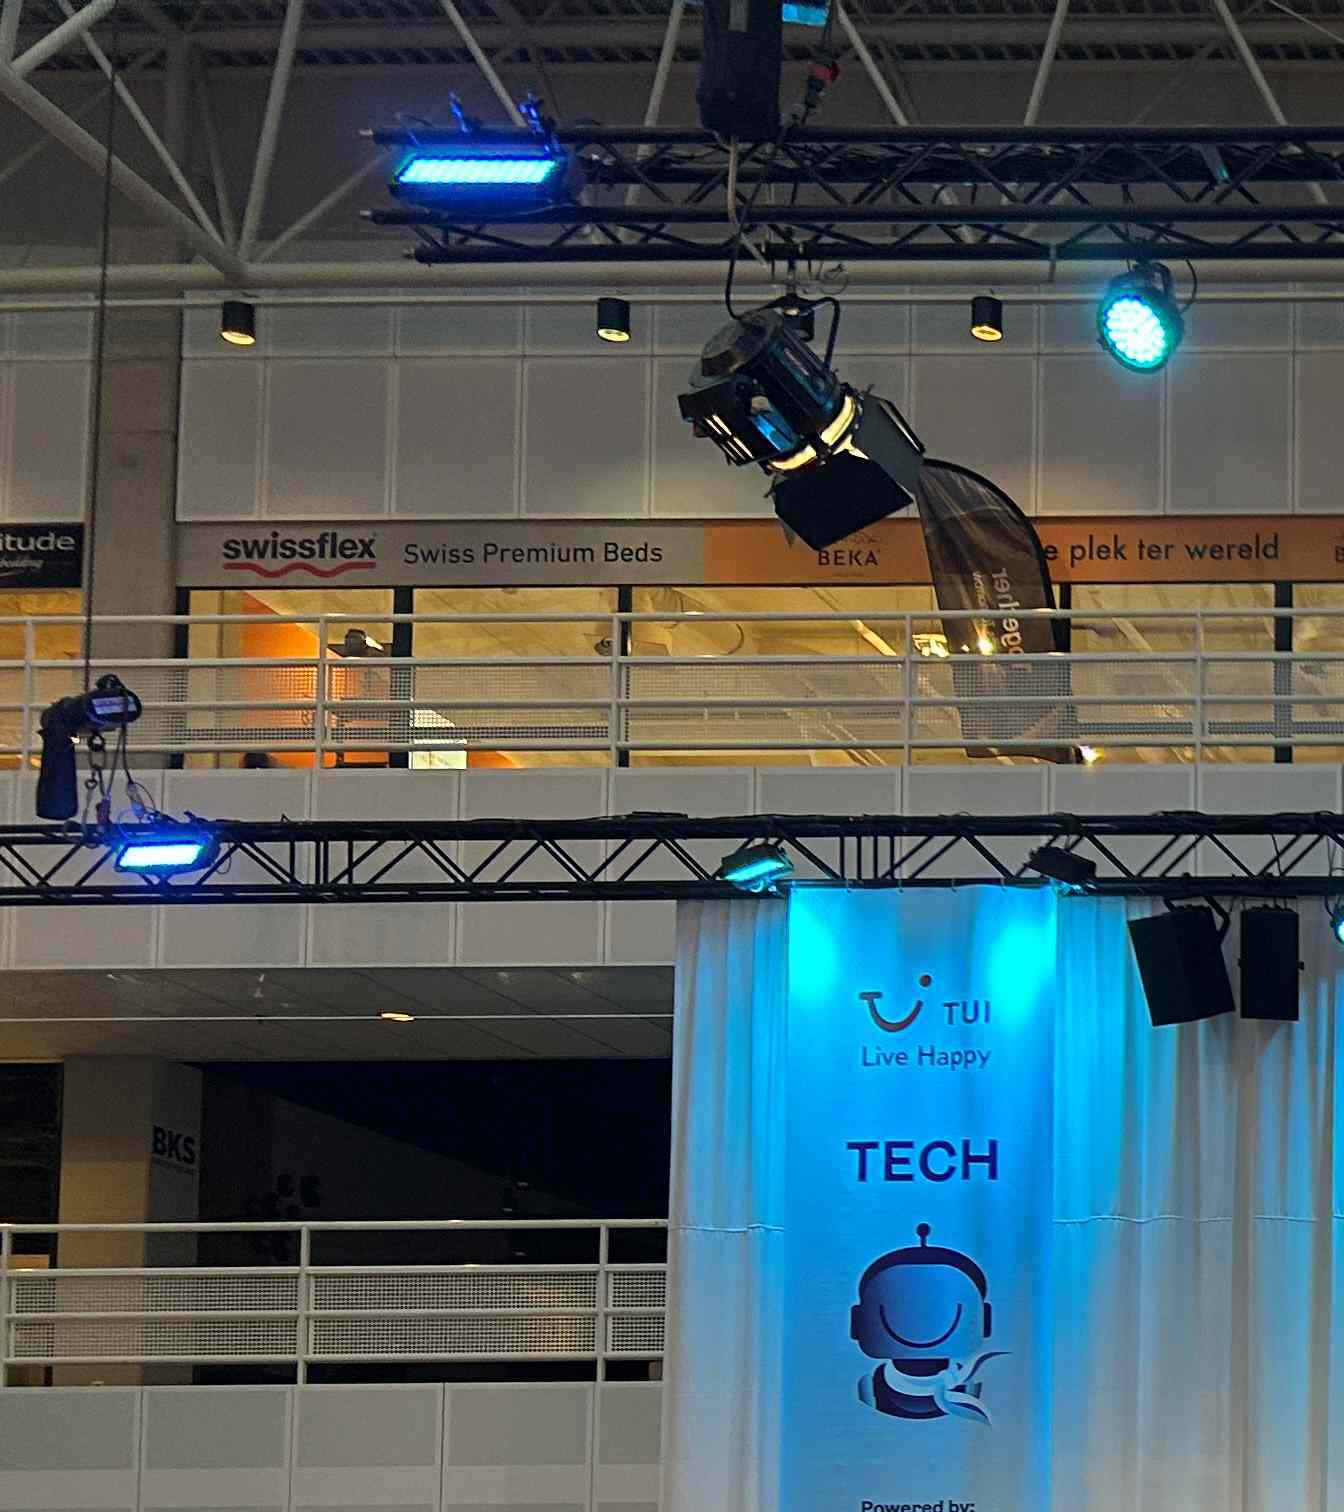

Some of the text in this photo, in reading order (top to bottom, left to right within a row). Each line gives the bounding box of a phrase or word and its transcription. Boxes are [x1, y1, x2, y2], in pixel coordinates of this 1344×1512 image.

[222, 532, 376, 560] swissflex
[403, 541, 663, 564] Swiss Premium Beds
[818, 550, 878, 566] BEKA
[1070, 535, 1127, 567] plek
[1138, 538, 1174, 561] ter
[1185, 533, 1279, 560] wereld
[944, 1000, 991, 1025] TUI
[861, 1045, 991, 1070] Live Happy
[153, 1125, 196, 1164] BKS
[846, 1139, 999, 1182] TECH
